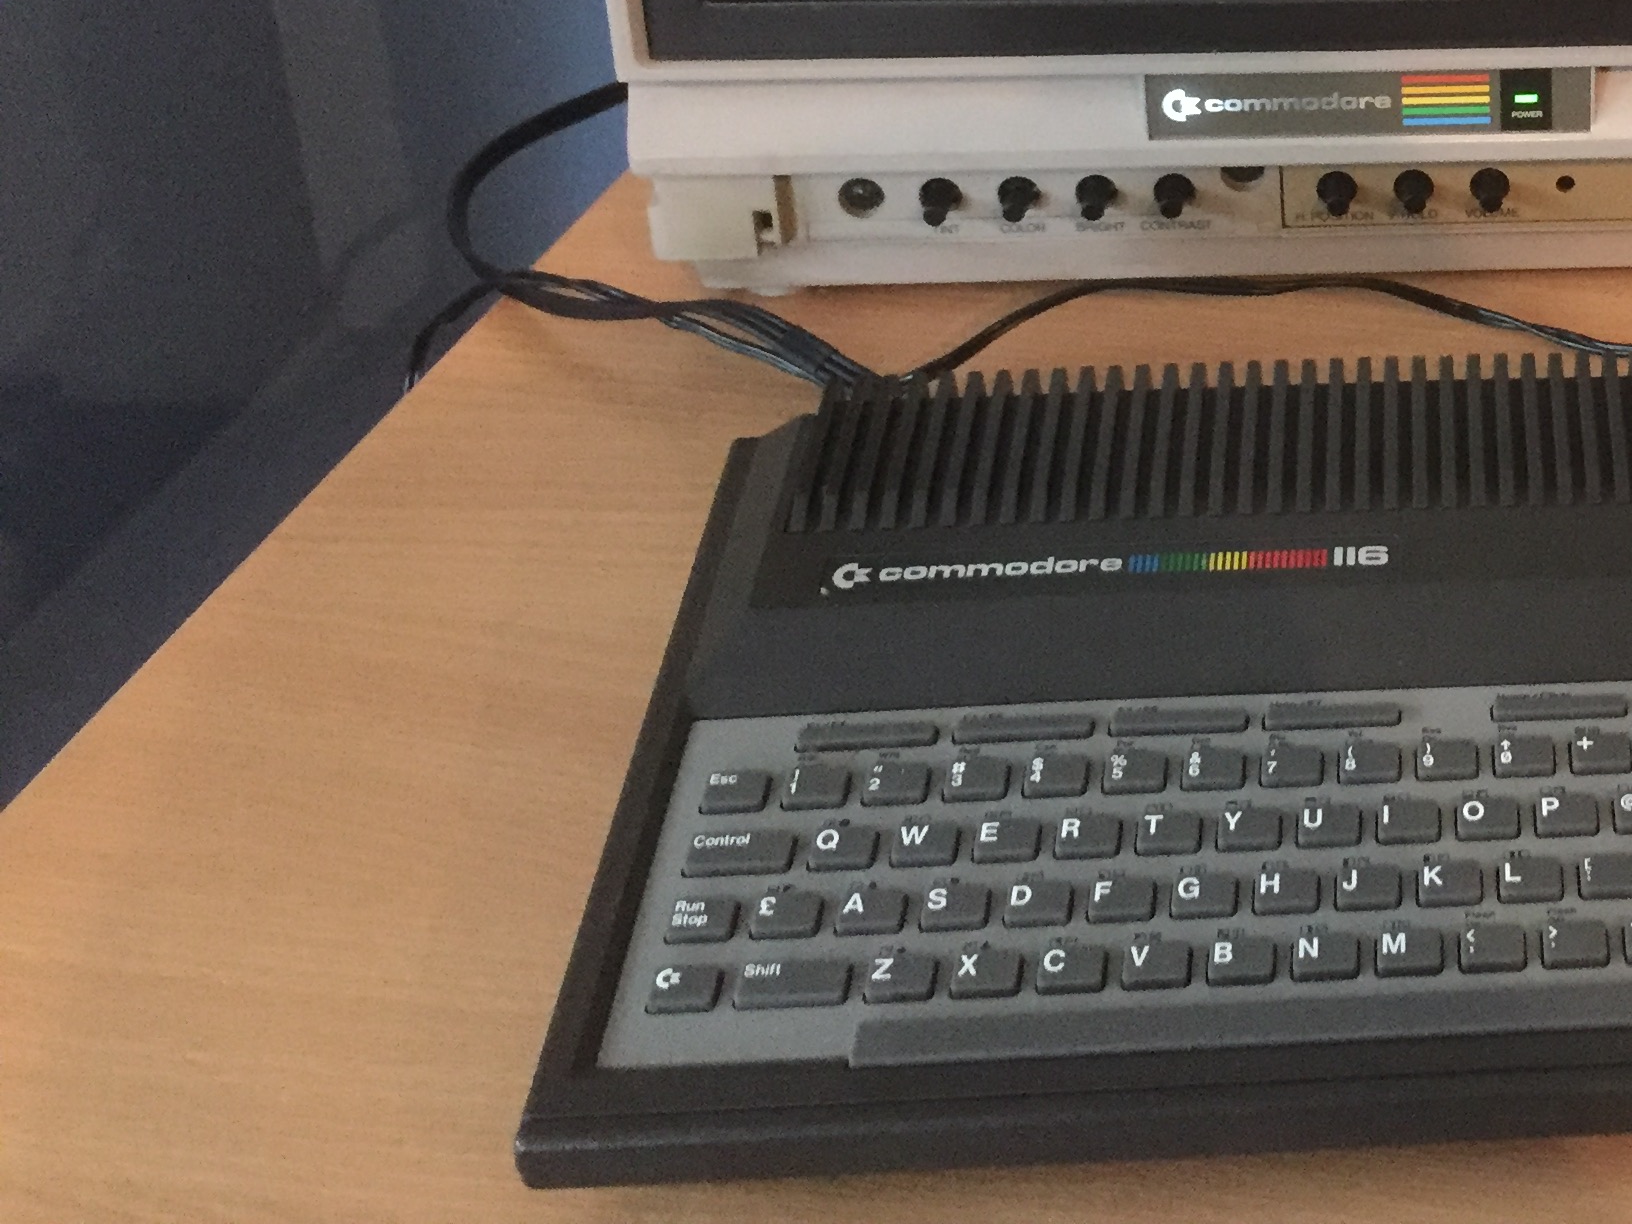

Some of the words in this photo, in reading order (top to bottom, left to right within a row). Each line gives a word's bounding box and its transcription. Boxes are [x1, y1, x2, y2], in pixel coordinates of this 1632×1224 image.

[1204, 91, 1392, 113] commodore
[1511, 110, 1543, 119] POWER
[878, 556, 1123, 583] commodore
[709, 773, 738, 786] Esc
[1382, 804, 1390, 825] I
[1462, 799, 1485, 822] O
[1541, 796, 1561, 817] P
[1060, 817, 1081, 839] R
[1144, 814, 1164, 836] T
[1224, 810, 1243, 832] Y
[1303, 808, 1323, 829] U
[693, 832, 752, 849] Control
[816, 829, 840, 851] Q
[900, 824, 930, 846] W
[979, 821, 1000, 842] E
[1342, 868, 1358, 892] J
[1422, 865, 1445, 887] K
[1503, 861, 1522, 883] L
[1093, 880, 1113, 903] F
[1177, 876, 1201, 900] G
[1259, 872, 1281, 895] H
[674, 899, 706, 913] Run
[842, 892, 865, 915] A
[927, 887, 948, 911] S
[1009, 884, 1033, 907] D
[671, 912, 709, 928] Stop
[1213, 941, 1234, 964] B
[1298, 936, 1320, 959] N
[1382, 932, 1407, 955] M
[957, 953, 979, 977] X
[1043, 948, 1066, 973] C
[1129, 945, 1150, 967] V
[743, 962, 782, 979] Shift
[870, 957, 895, 981] Z
